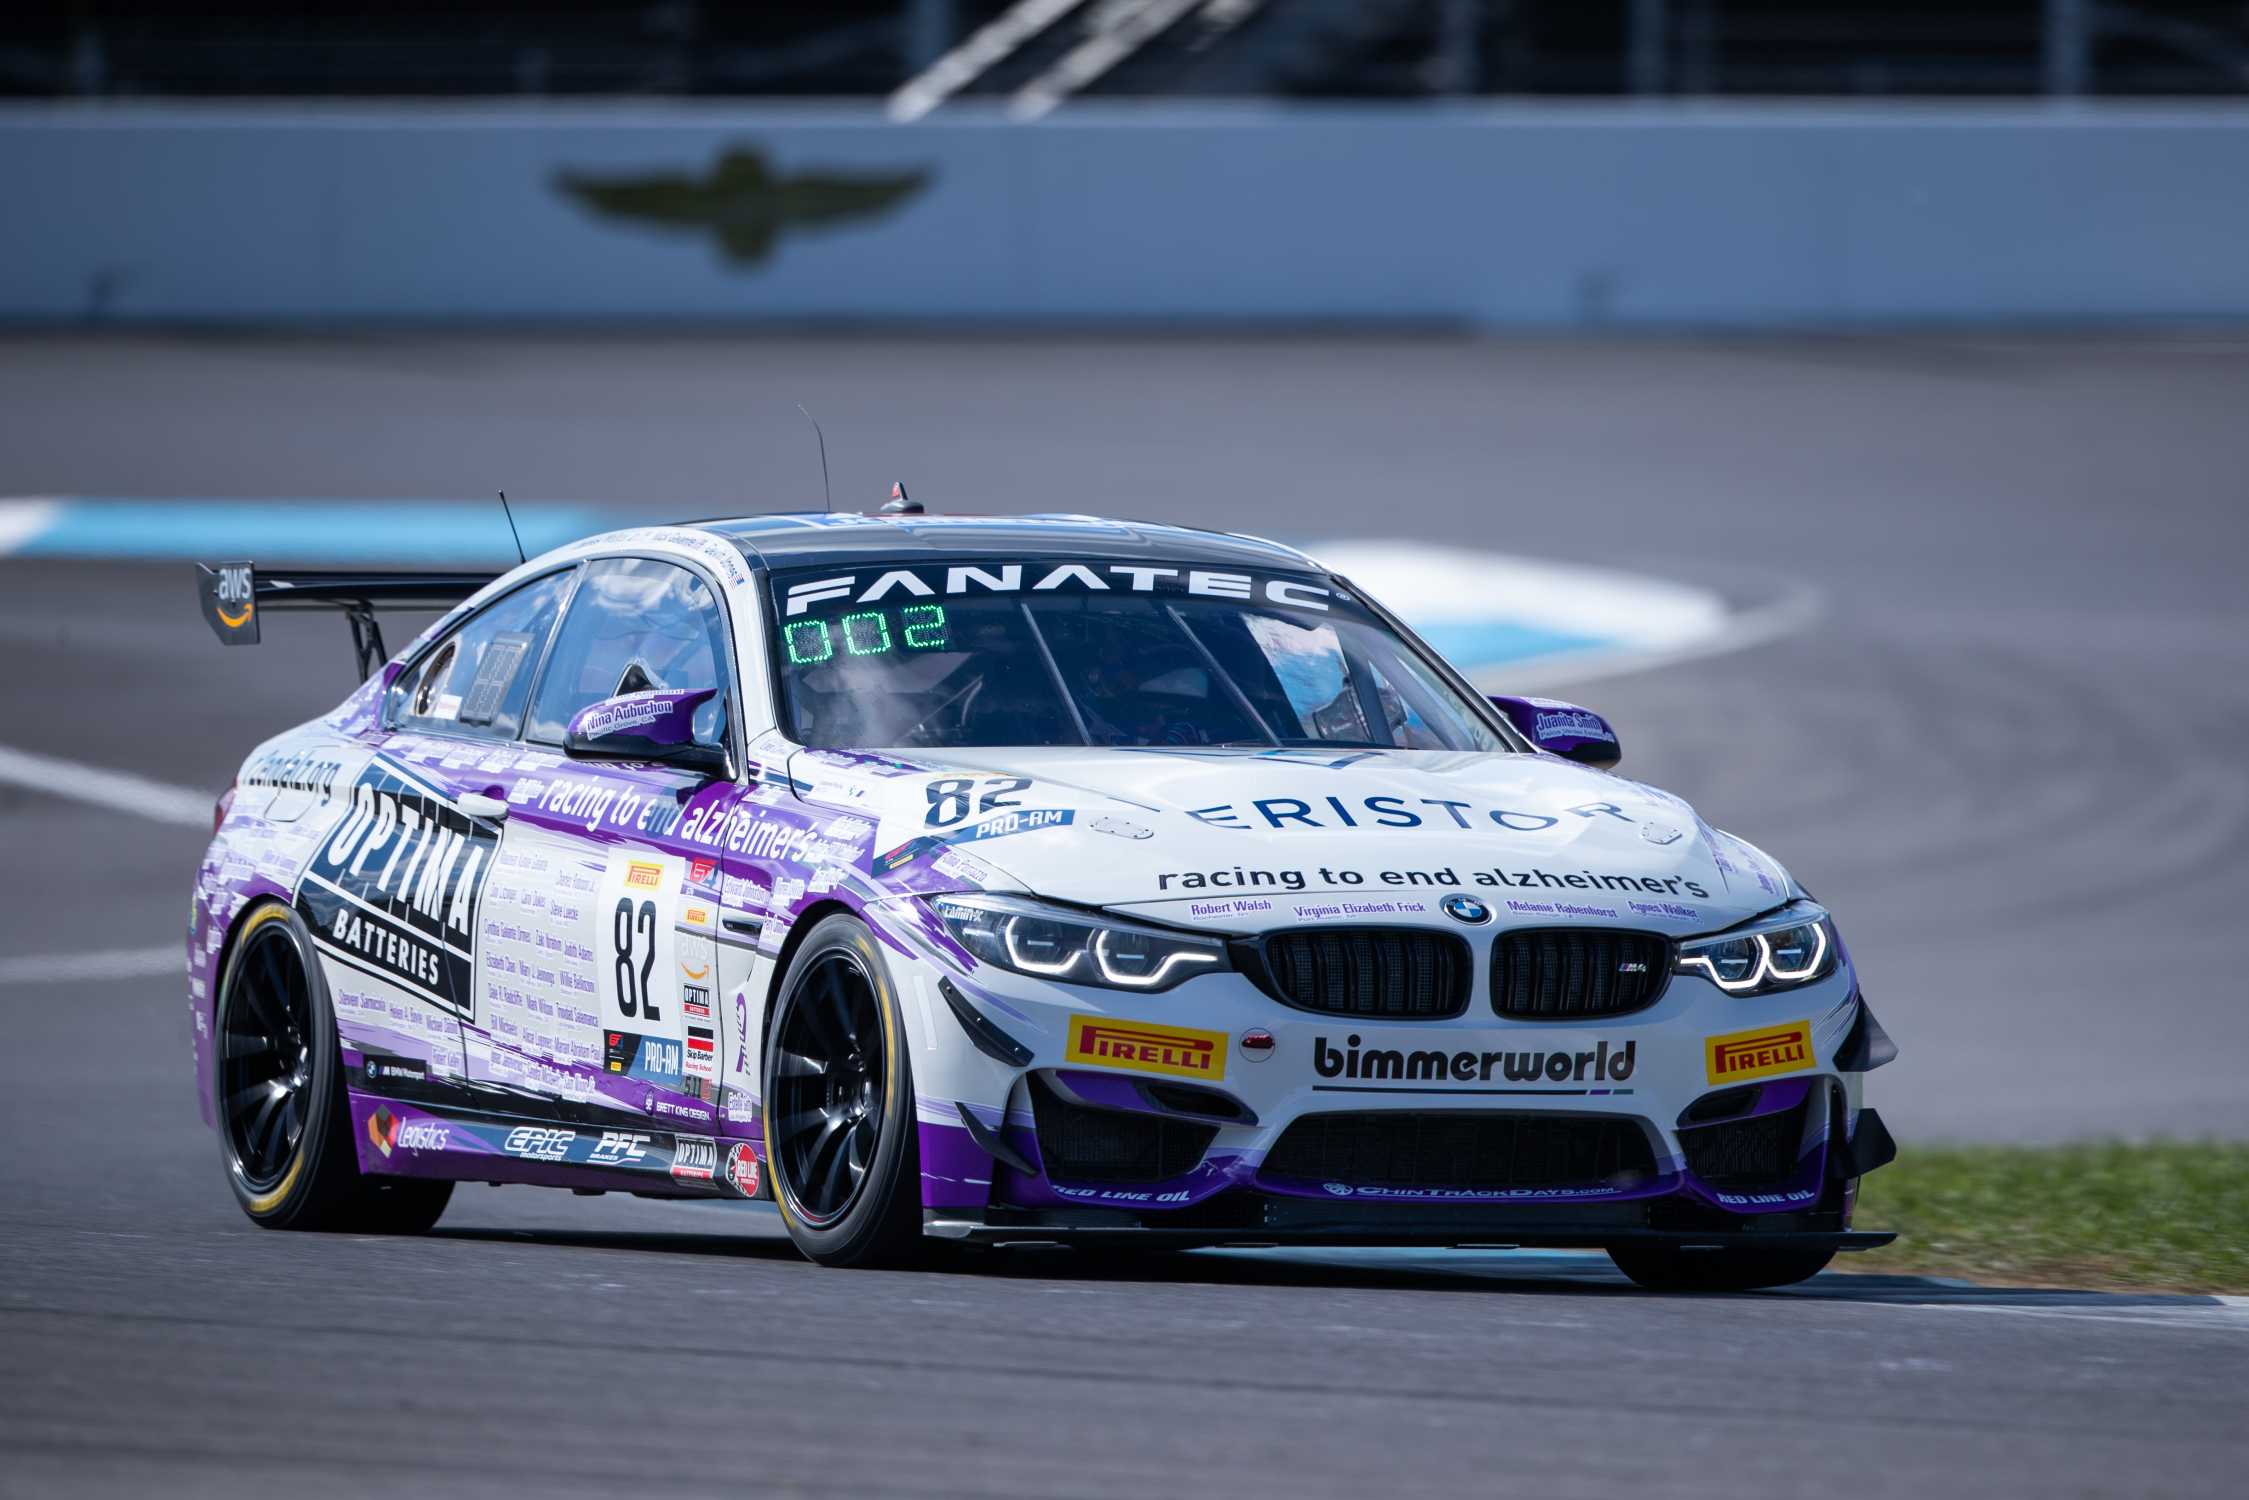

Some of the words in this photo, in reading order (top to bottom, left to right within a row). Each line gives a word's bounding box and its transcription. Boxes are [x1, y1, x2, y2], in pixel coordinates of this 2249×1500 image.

[218, 567, 251, 602] aws
[786, 564, 1329, 616] FANATEC
[784, 605, 946, 664] 002
[587, 711, 611, 731] Nina
[615, 701, 672, 722] Aubuchon
[1537, 713, 1575, 730] Juanita
[1577, 713, 1601, 729] Smith
[539, 776, 610, 832] racing
[610, 787, 640, 826] to
[637, 796, 684, 837] end
[924, 777, 1034, 829] 82
[1184, 796, 1635, 832] ERISTOR
[976, 811, 1063, 839] PRO-AM
[328, 782, 484, 936] OPTIMA
[629, 865, 661, 886] PIRELLI
[1159, 866, 1305, 890] racing
[1319, 867, 1364, 885] to
[1381, 867, 1461, 887] end
[1473, 867, 1709, 899] alzheimer's
[1191, 903, 1231, 916] Robert
[1232, 900, 1272, 912] Walsh
[1294, 904, 1341, 919] Virginia
[1342, 902, 1395, 914] Elizabeth
[1397, 902, 1427, 913] Frick
[1506, 900, 1553, 914] Melanie
[1555, 903, 1618, 919] Rabenhorst
[1628, 900, 1660, 914] Agnes
[1661, 904, 1698, 919] Walker
[332, 908, 439, 986] BATTERIES
[615, 897, 661, 1022] 82
[1620, 961, 1647, 973] M4
[684, 986, 710, 1006] OPTIMA
[644, 1041, 679, 1075] PRO-AM
[686, 1049, 698, 1060] Skip
[698, 1050, 713, 1062] Barber
[1079, 1025, 1214, 1070] PIRELLI
[1314, 1033, 1636, 1081] bimmerworld
[1715, 1031, 1804, 1074] PIRELLI
[656, 1101, 675, 1113] BRETT
[675, 1104, 689, 1116] KING
[398, 1117, 450, 1157] Legistics
[504, 1126, 576, 1156] EPIC
[594, 1131, 651, 1158] PFC
[519, 1151, 563, 1162] motorsports
[678, 1142, 713, 1167] OPTIMA
[1051, 1184, 1097, 1197] RED
[1101, 1191, 1152, 1201] LINE
[1156, 1190, 1191, 1202] OIL
[1716, 1192, 1748, 1204] RED
[1750, 1194, 1785, 1204] LINE
[1787, 1190, 1815, 1201] OIL
